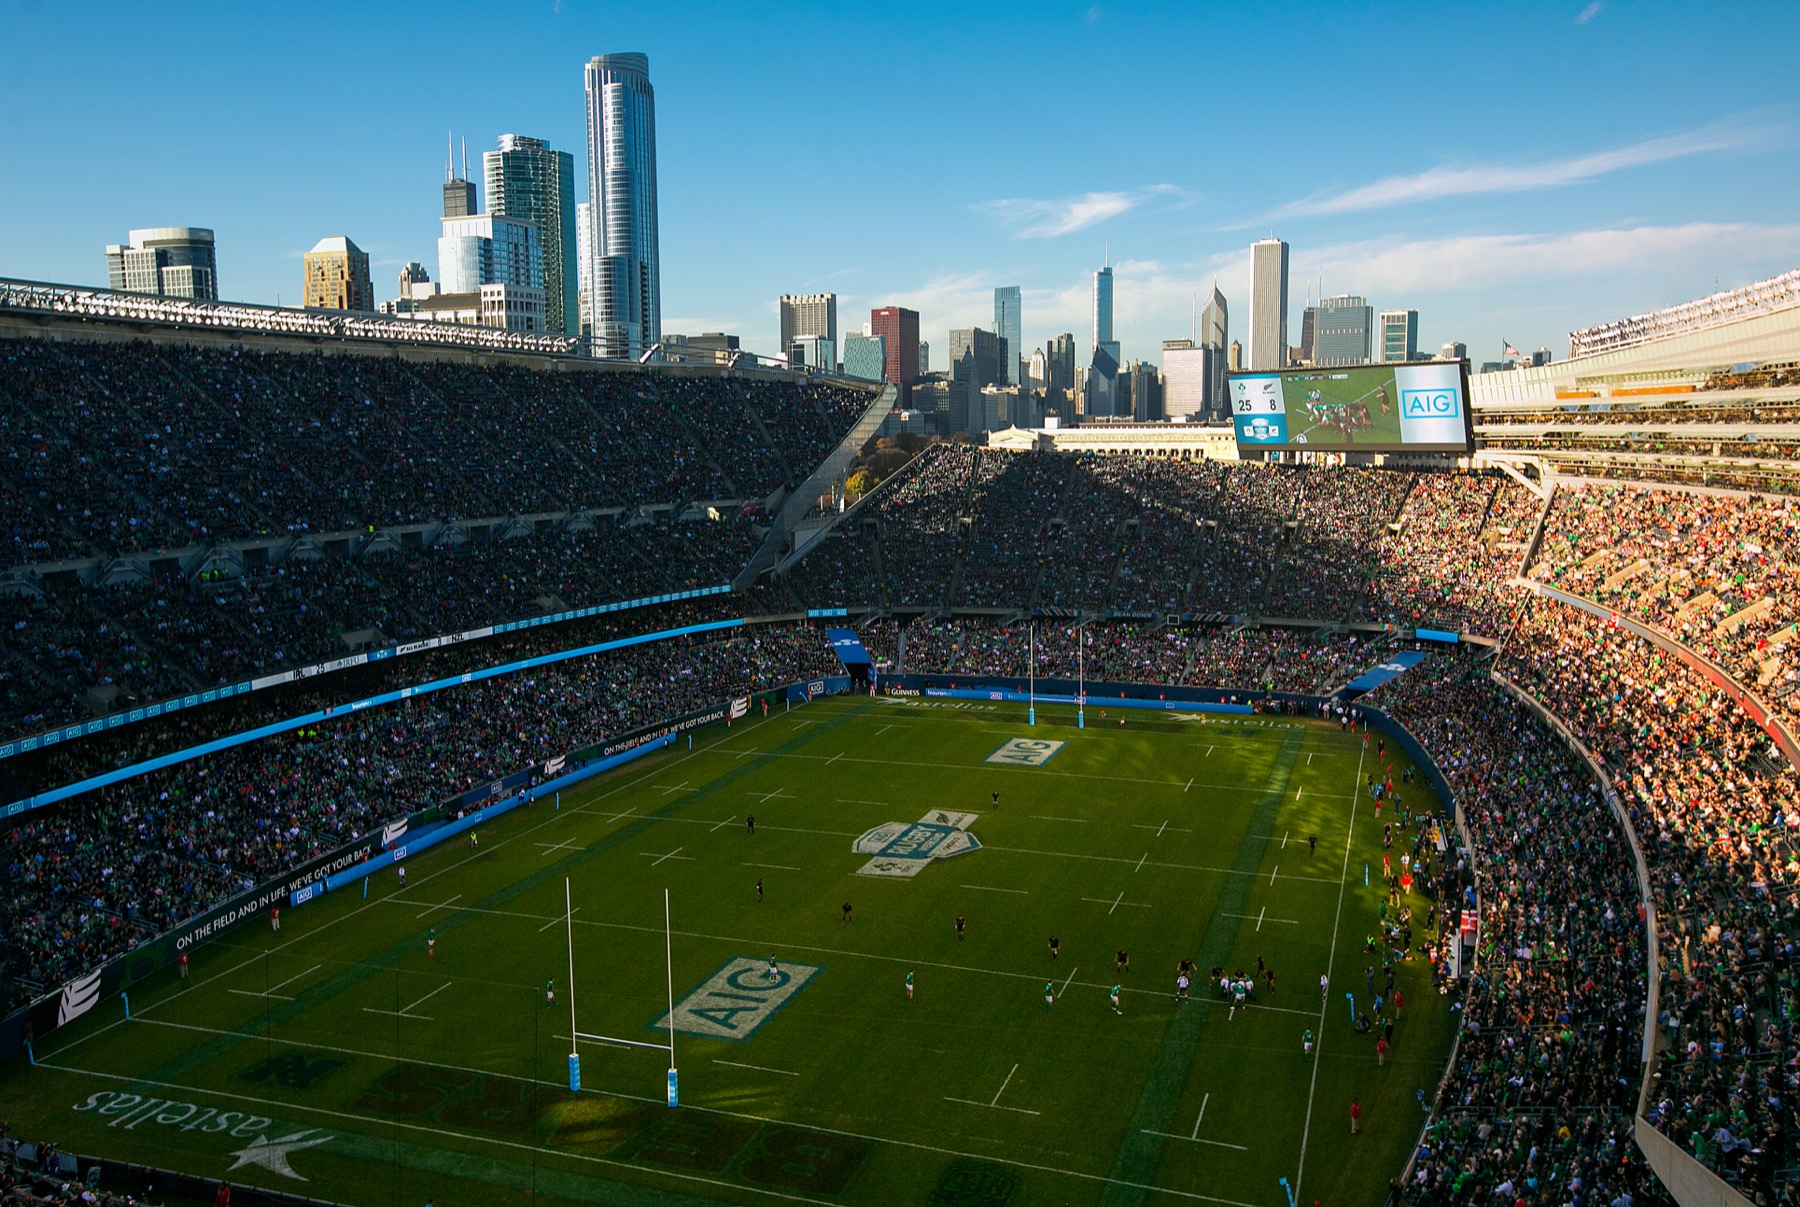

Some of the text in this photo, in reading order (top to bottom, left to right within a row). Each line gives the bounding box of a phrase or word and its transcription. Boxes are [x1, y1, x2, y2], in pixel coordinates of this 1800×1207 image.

[1238, 399, 1252, 412] 25
[1269, 399, 1277, 411] 8
[1409, 394, 1451, 413] AIG
[293, 669, 306, 680] IRL
[316, 664, 325, 674] 25
[891, 688, 920, 697] GUINNESS
[604, 746, 615, 756] ON
[640, 733, 651, 744] AND
[685, 719, 696, 728] GOT
[697, 714, 711, 724] YOUR
[1001, 740, 1051, 763] AIG
[10, 803, 22, 814] AIG
[886, 825, 937, 855] RUGBY
[176, 932, 193, 950] ON
[194, 922, 212, 942] THE
[213, 911, 236, 932] FIELD
[238, 900, 258, 920] AND
[259, 894, 269, 908] IN
[270, 887, 289, 903] LIFE,
[289, 872, 313, 891] WE'VE
[313, 863, 331, 879] GOT
[331, 854, 353, 871] YOUR
[687, 967, 791, 1031] AIG
[72, 1090, 273, 1138] astellas
